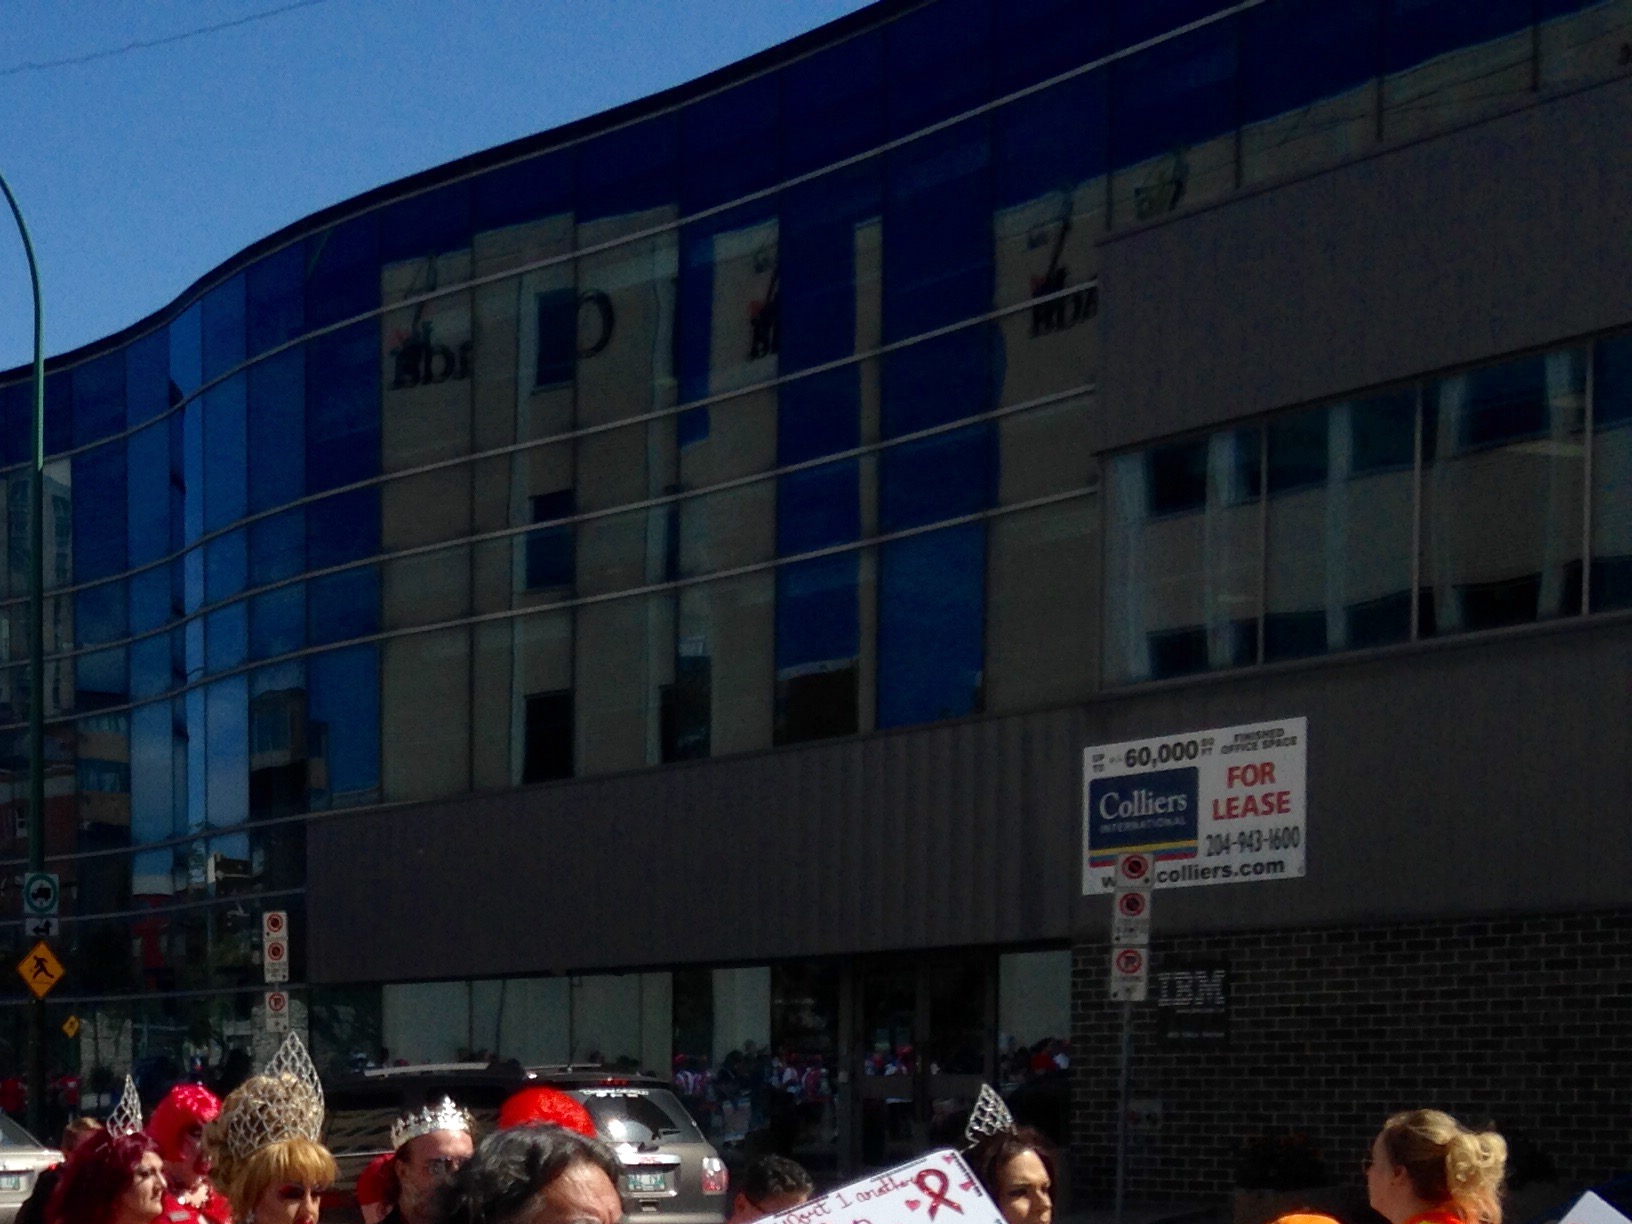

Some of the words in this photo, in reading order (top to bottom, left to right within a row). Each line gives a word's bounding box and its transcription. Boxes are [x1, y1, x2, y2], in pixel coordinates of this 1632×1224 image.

[1124, 740, 1200, 769] 60,000
[1226, 761, 1276, 789] FOR
[1099, 786, 1188, 821] Colliers
[1212, 790, 1292, 821] LEASE
[1157, 970, 1226, 1008] IBM
